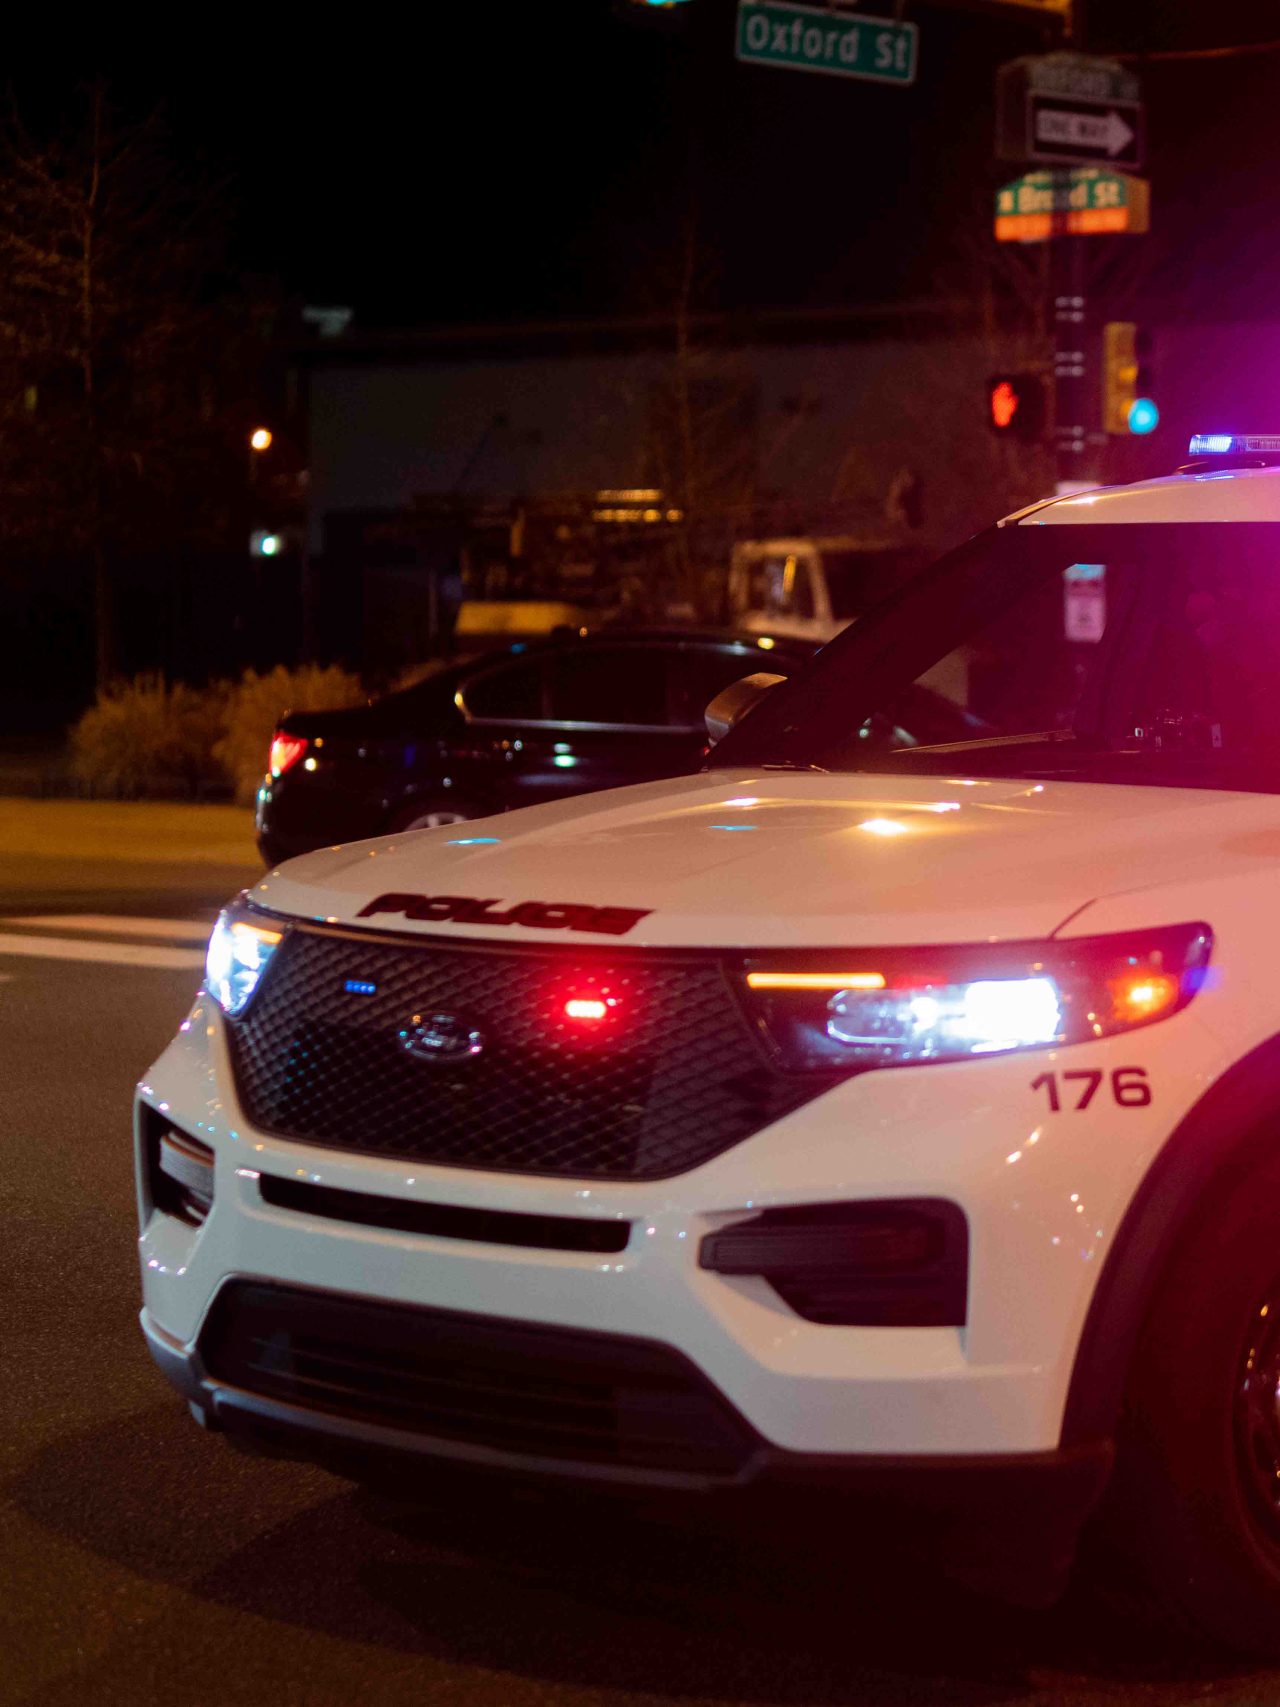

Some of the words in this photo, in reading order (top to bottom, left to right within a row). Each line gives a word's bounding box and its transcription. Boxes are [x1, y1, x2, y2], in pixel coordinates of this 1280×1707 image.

[746, 14, 860, 64] Oxford
[874, 32, 908, 70] St
[1017, 183, 1088, 213] Brod
[1094, 181, 1120, 208] St
[355, 893, 658, 936] POLICE
[1030, 1066, 1152, 1113] 176
